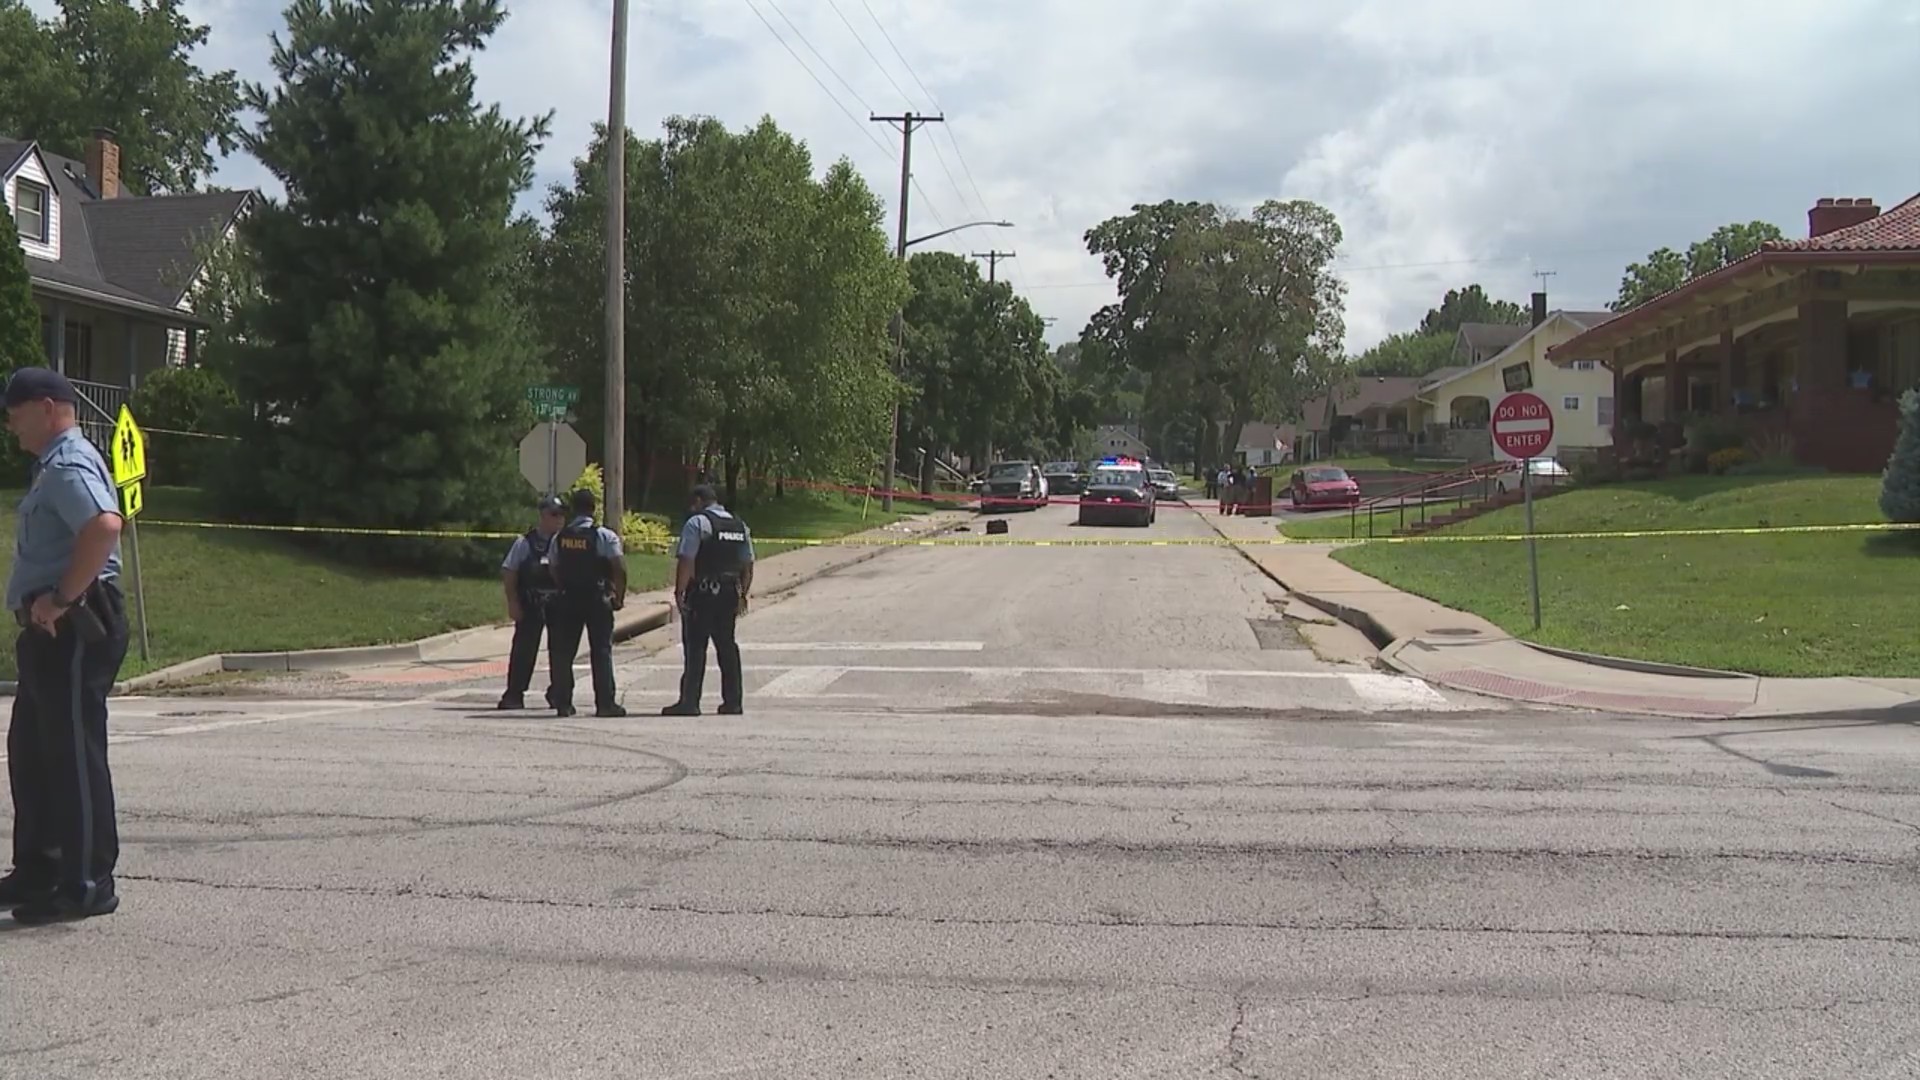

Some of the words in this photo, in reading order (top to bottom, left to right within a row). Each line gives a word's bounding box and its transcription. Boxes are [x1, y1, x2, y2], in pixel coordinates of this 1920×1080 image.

[527, 387, 565, 400] STRONG
[1499, 406, 1515, 418] DO
[1522, 404, 1544, 417] NOT
[1506, 434, 1542, 447] ENTER
[718, 531, 744, 541] POLICE
[561, 538, 588, 550] POLICE
